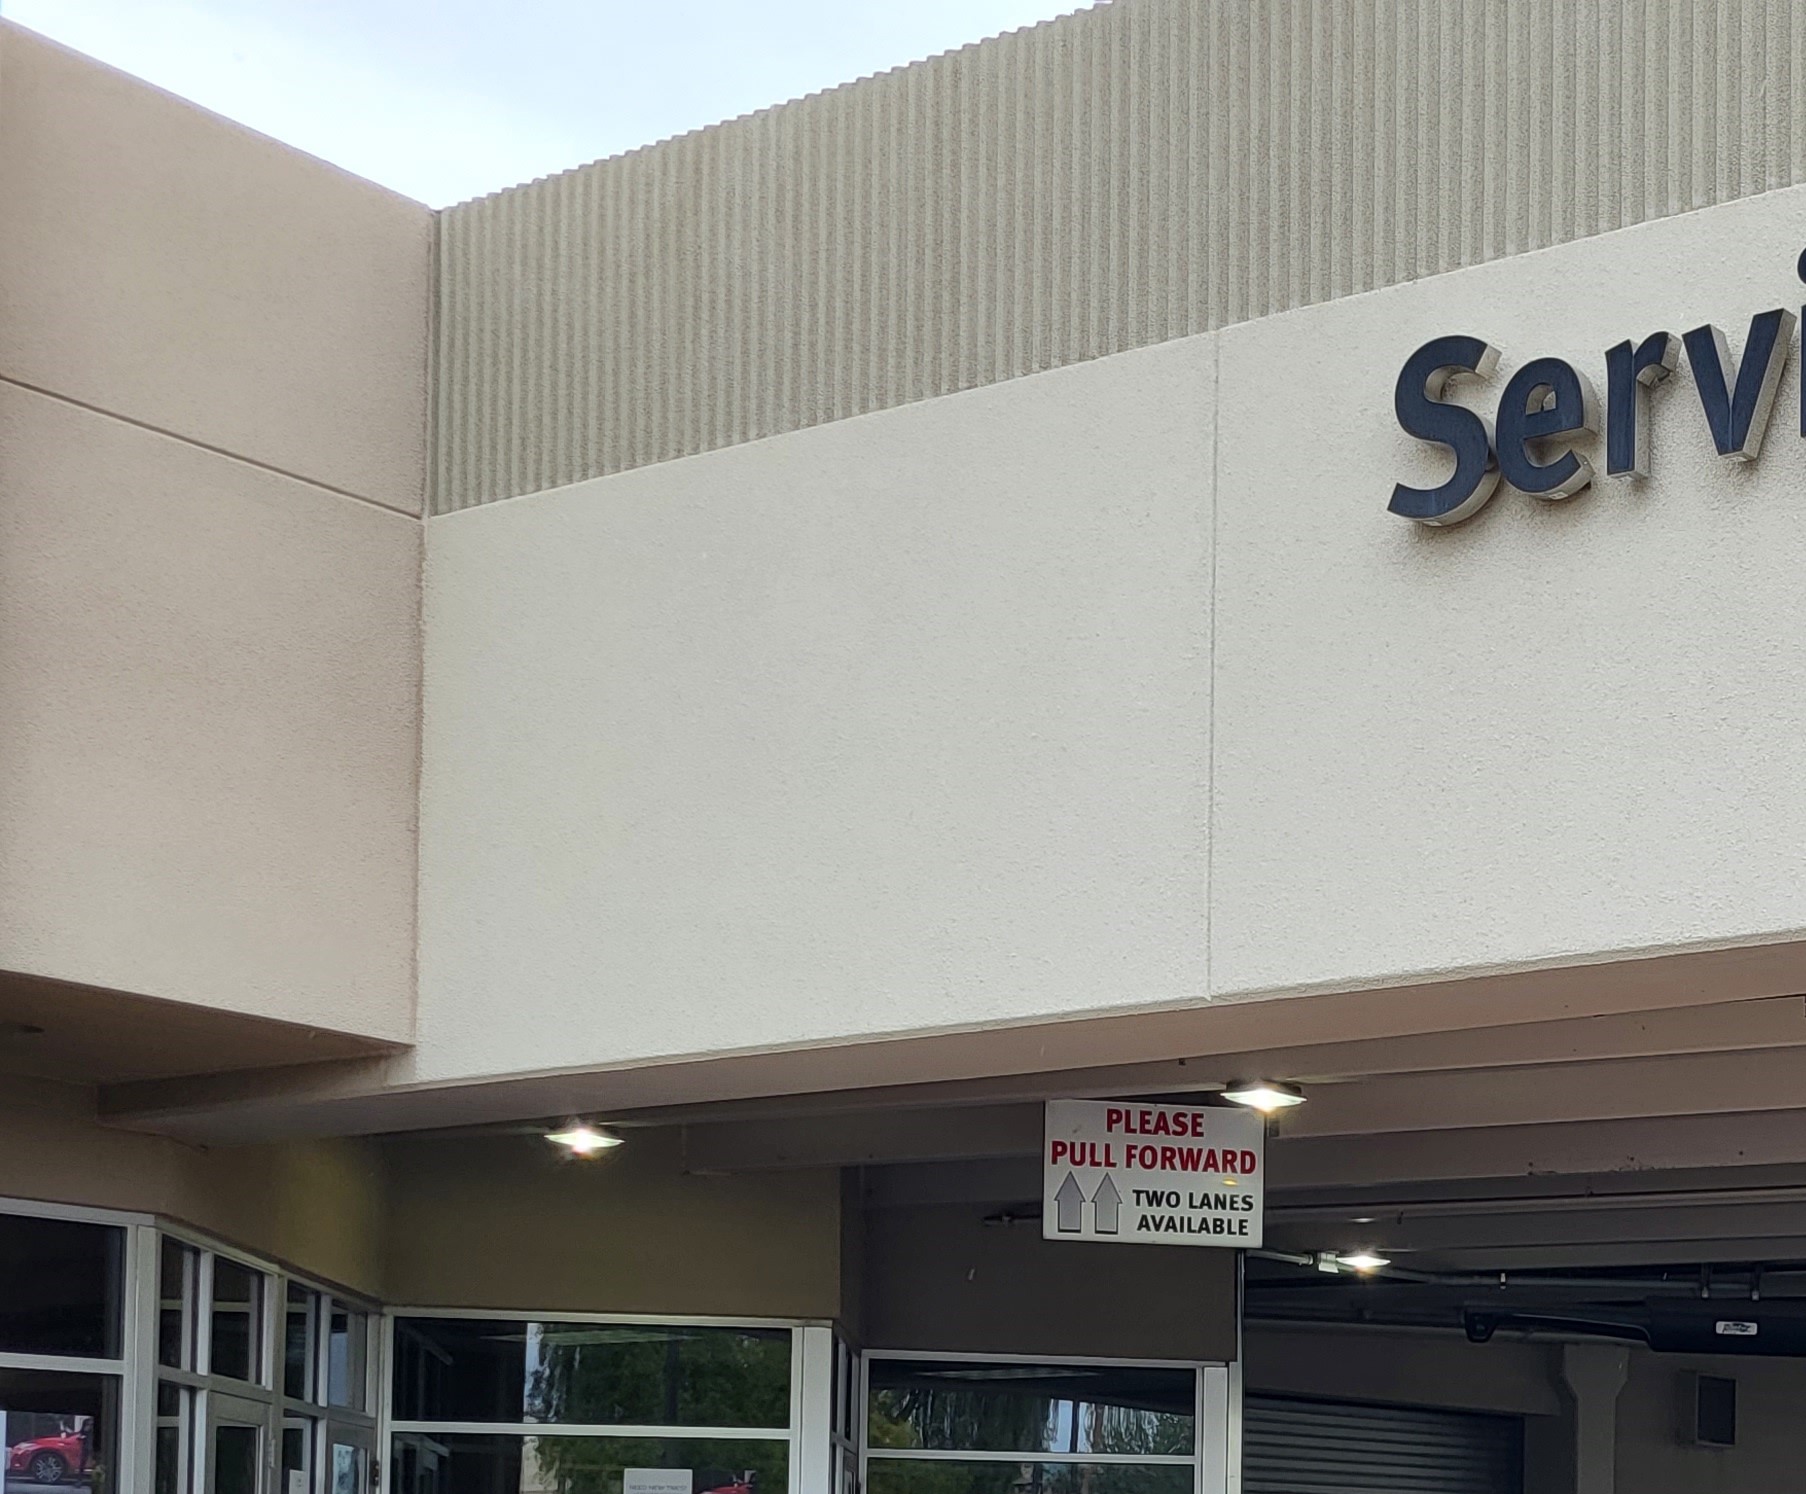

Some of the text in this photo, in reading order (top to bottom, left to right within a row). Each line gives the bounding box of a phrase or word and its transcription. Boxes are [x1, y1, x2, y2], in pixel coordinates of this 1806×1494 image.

[1106, 1108, 1205, 1137] PLEASE
[1051, 1140, 1257, 1175] PULL FORWARD
[1132, 1189, 1254, 1212] TWO LANES
[1136, 1214, 1249, 1236] AVAILABLE
